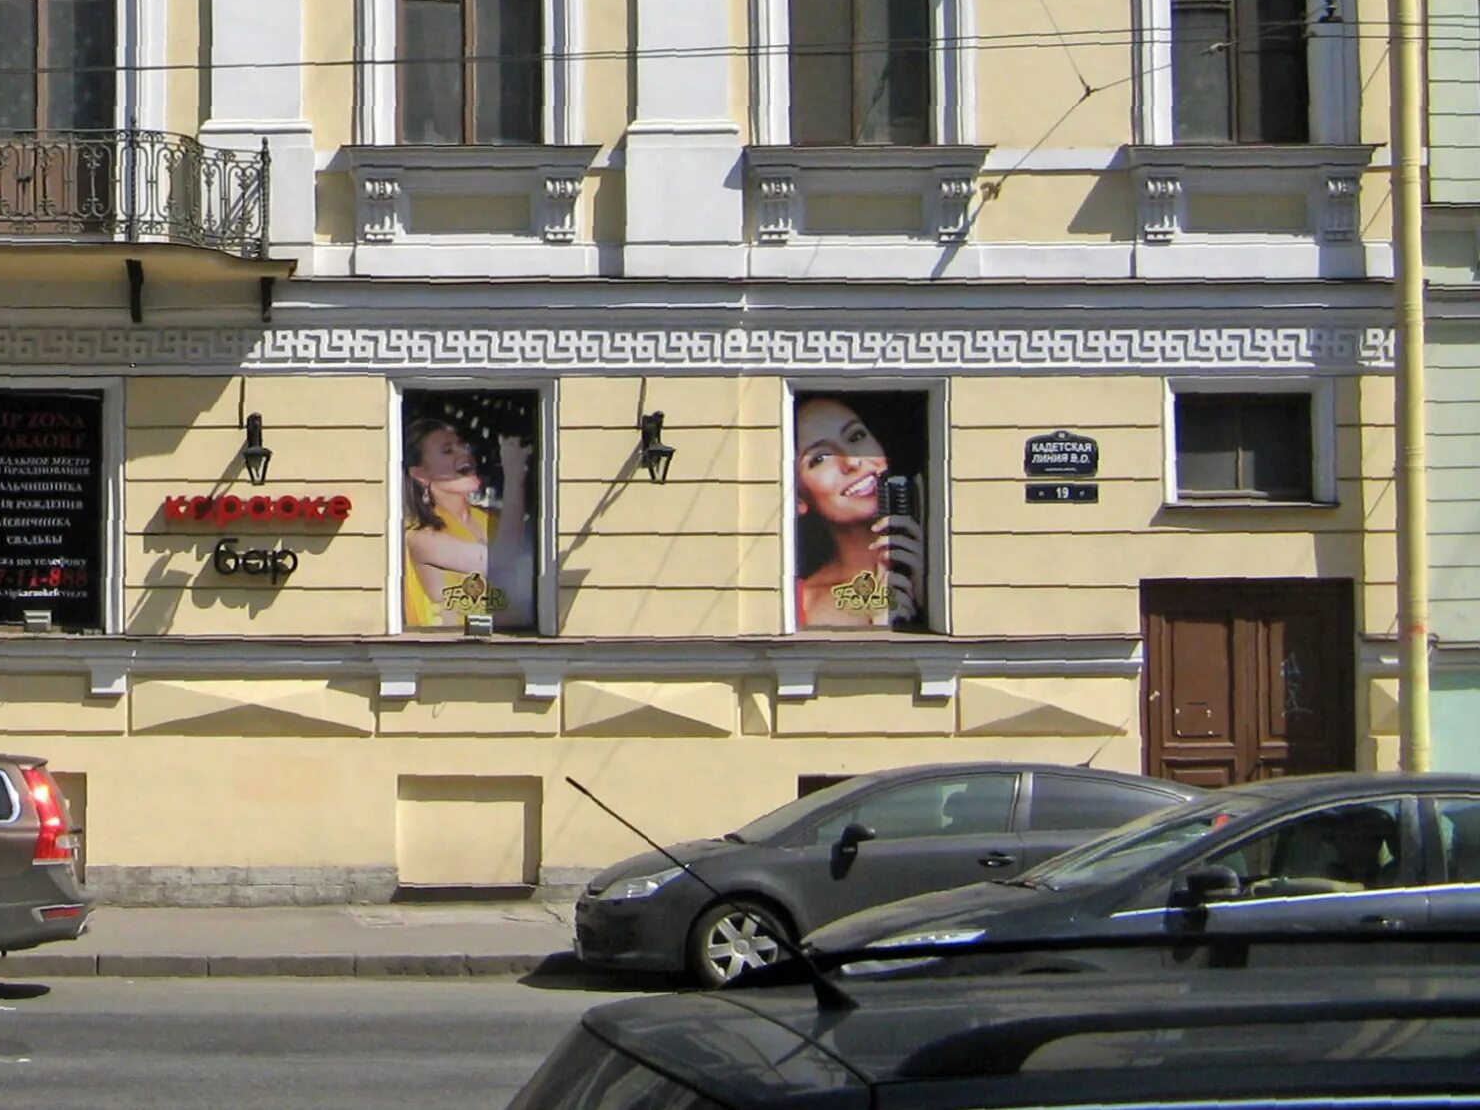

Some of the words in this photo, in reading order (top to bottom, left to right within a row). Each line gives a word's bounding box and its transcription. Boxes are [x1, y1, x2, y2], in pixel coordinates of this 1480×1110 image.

[1031, 442, 1092, 453] КАДЕТСКАЯ
[1031, 453, 1069, 464] ЛИНИЯ
[1055, 487, 1069, 499] 19
[164, 494, 352, 529] караоке
[6, 535, 63, 545] СВАДЬБЫ
[214, 538, 299, 585] бар
